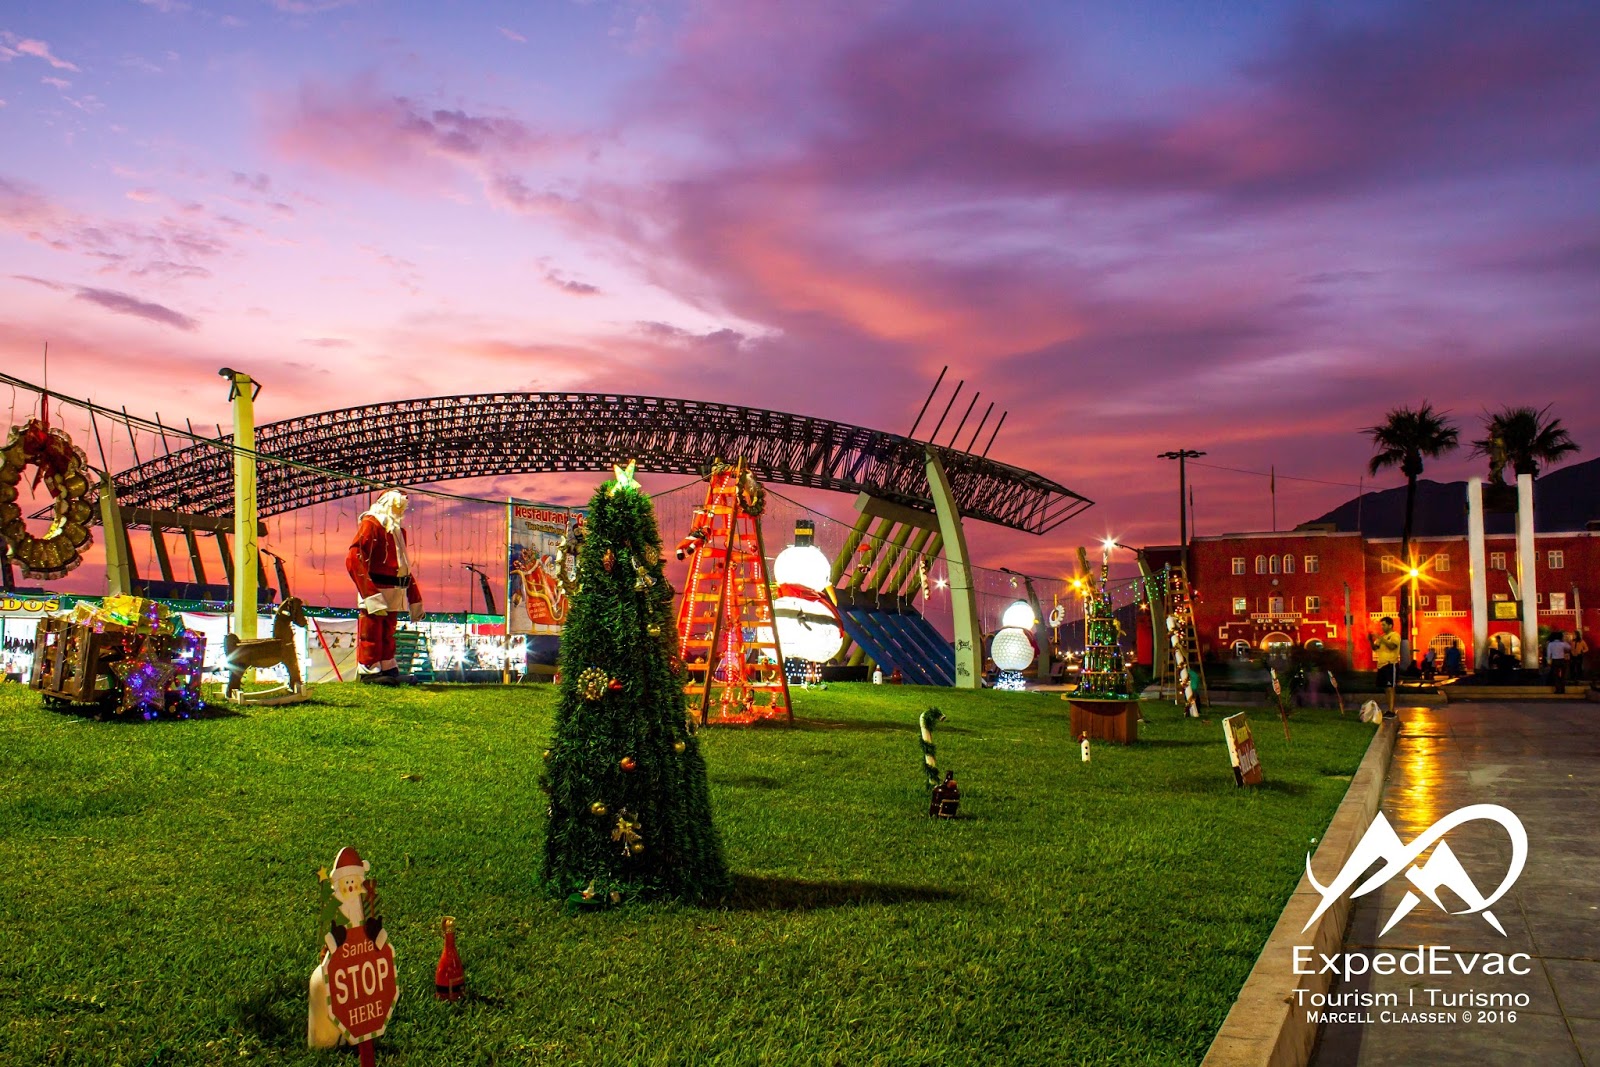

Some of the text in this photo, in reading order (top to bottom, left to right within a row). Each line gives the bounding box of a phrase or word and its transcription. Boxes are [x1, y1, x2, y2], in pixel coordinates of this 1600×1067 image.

[514, 505, 568, 525] Restaurant
[342, 940, 374, 957] Santa
[334, 957, 389, 1004] STOP
[348, 1000, 384, 1026] HERE
